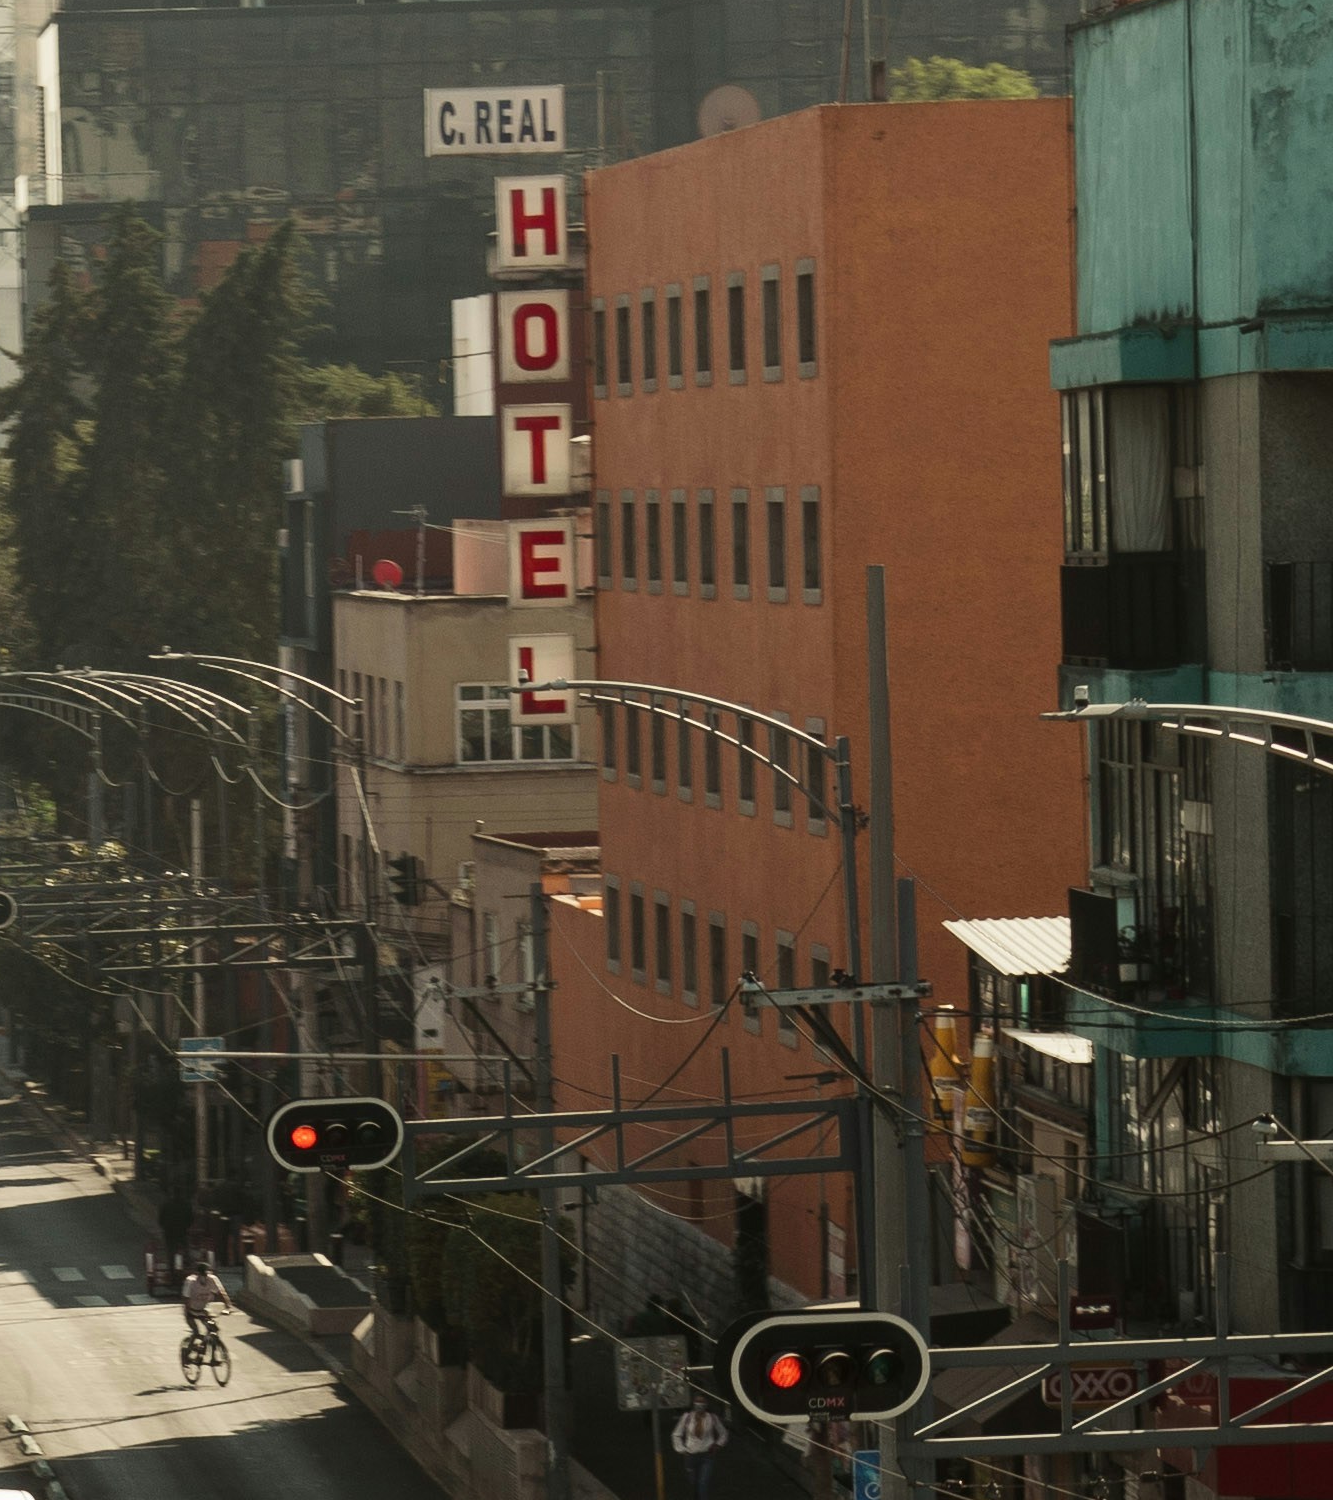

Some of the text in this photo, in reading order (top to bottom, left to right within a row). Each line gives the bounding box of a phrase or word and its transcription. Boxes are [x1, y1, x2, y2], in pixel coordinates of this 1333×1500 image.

[440, 99, 556, 146] C. REAL
[510, 186, 568, 715] HOTEL
[808, 1397, 846, 1409] CDMX
[1049, 1368, 1134, 1399] OXXO
